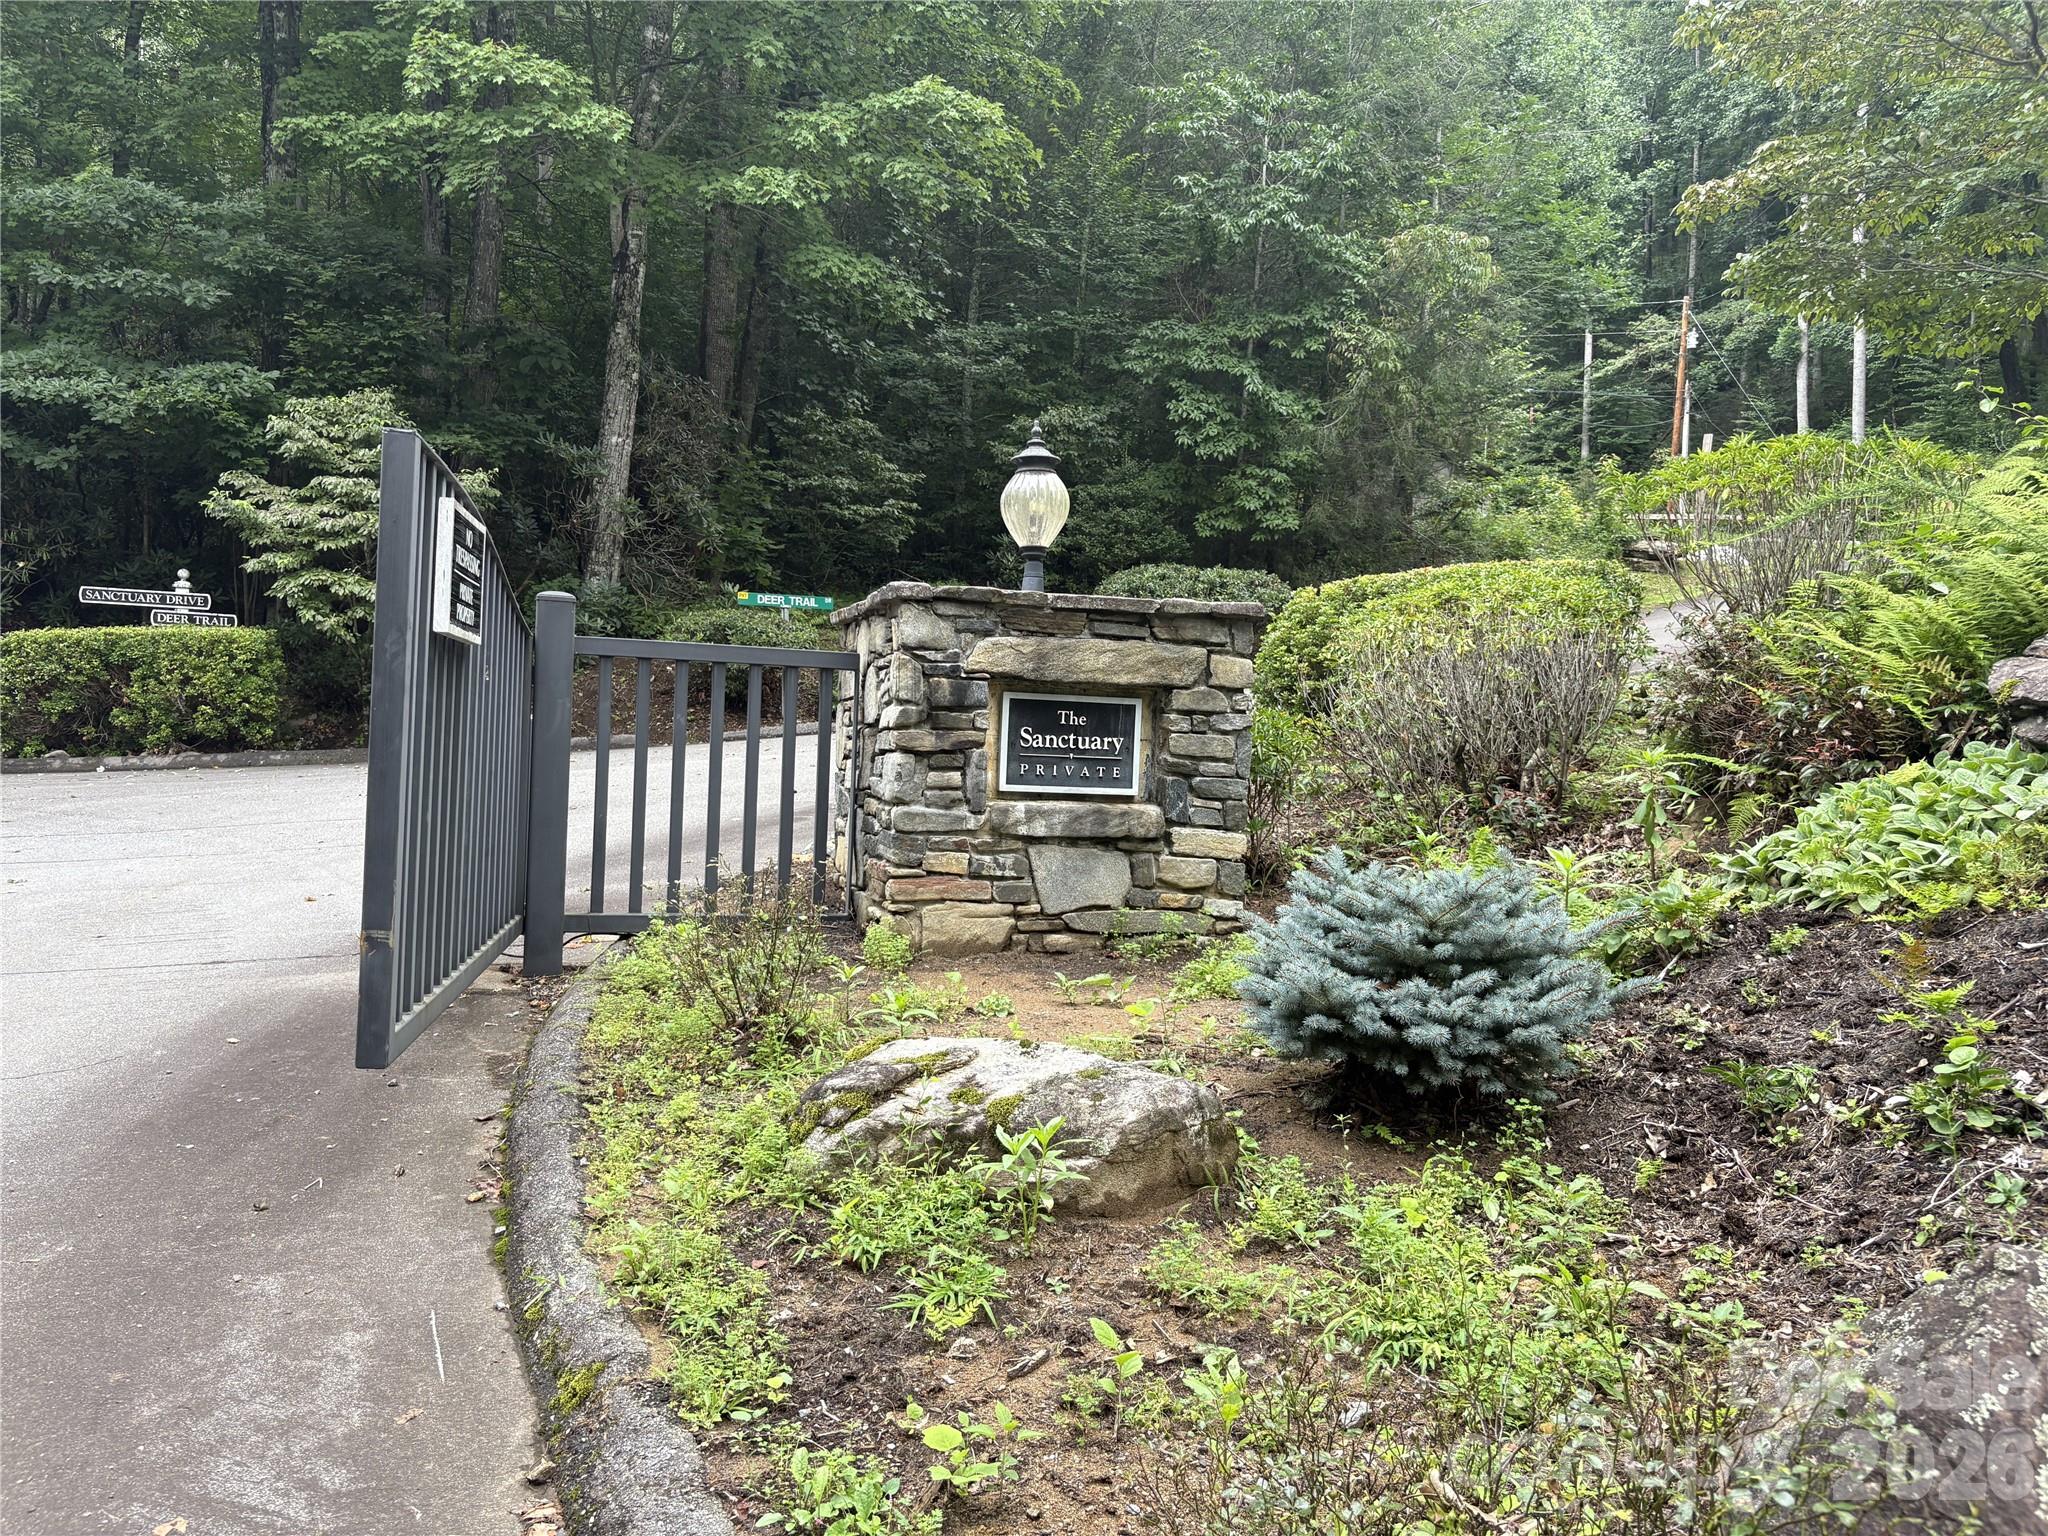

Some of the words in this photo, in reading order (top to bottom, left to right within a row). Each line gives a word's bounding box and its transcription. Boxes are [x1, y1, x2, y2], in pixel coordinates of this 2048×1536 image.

[465, 528, 474, 549] NO
[85, 589, 162, 604] SANCTUARY
[166, 595, 205, 607] DRIVE
[757, 594, 785, 605] DEER
[790, 596, 818, 607] TRAIL
[157, 613, 190, 624] DEER
[193, 615, 232, 627] TRAIL
[1057, 710, 1087, 726] The
[1019, 726, 1124, 755] Sanctuary
[1019, 763, 1121, 778] PRIVATE
